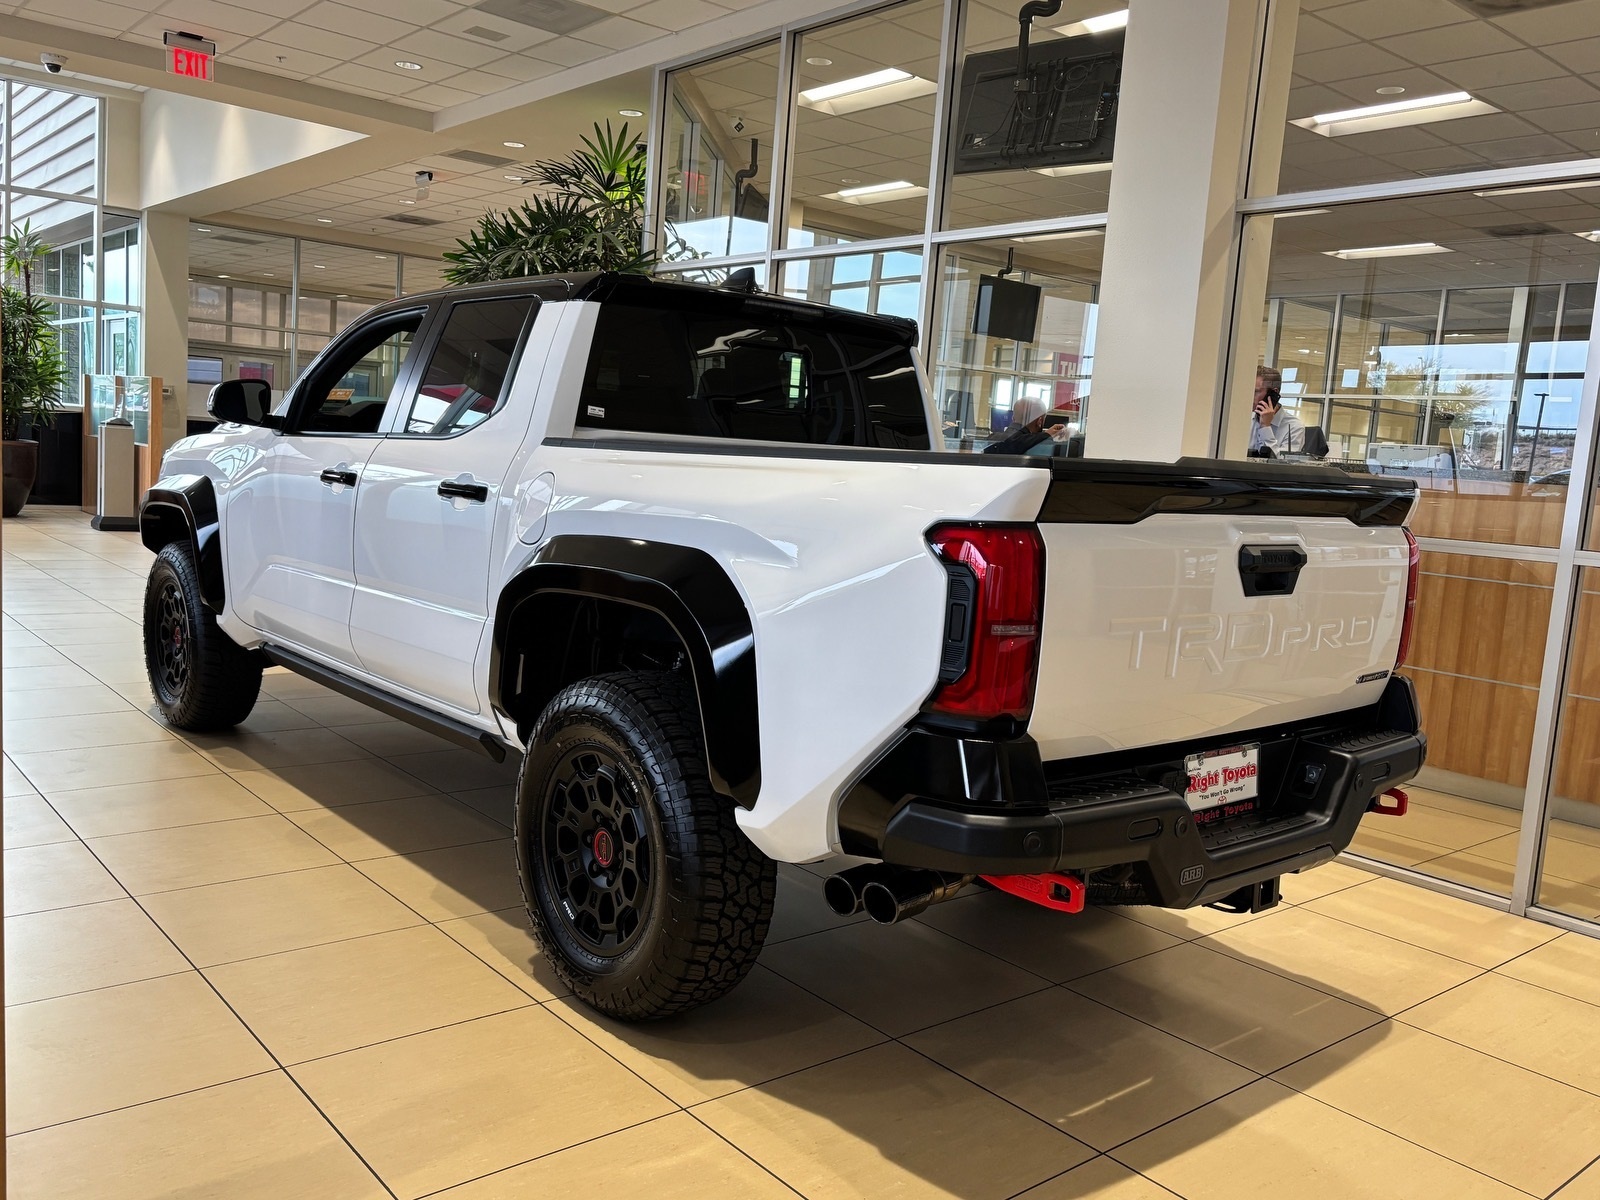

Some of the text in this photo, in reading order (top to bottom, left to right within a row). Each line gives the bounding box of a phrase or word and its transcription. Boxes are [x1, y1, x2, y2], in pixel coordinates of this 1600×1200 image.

[173, 47, 209, 80] EXIT
[1109, 611, 1375, 679] TRD PRO
[1187, 763, 1258, 793] Right Toyota
[1193, 802, 1254, 823] Right Toyota
[1182, 867, 1202, 882] ARB
[562, 900, 575, 920] PRO
